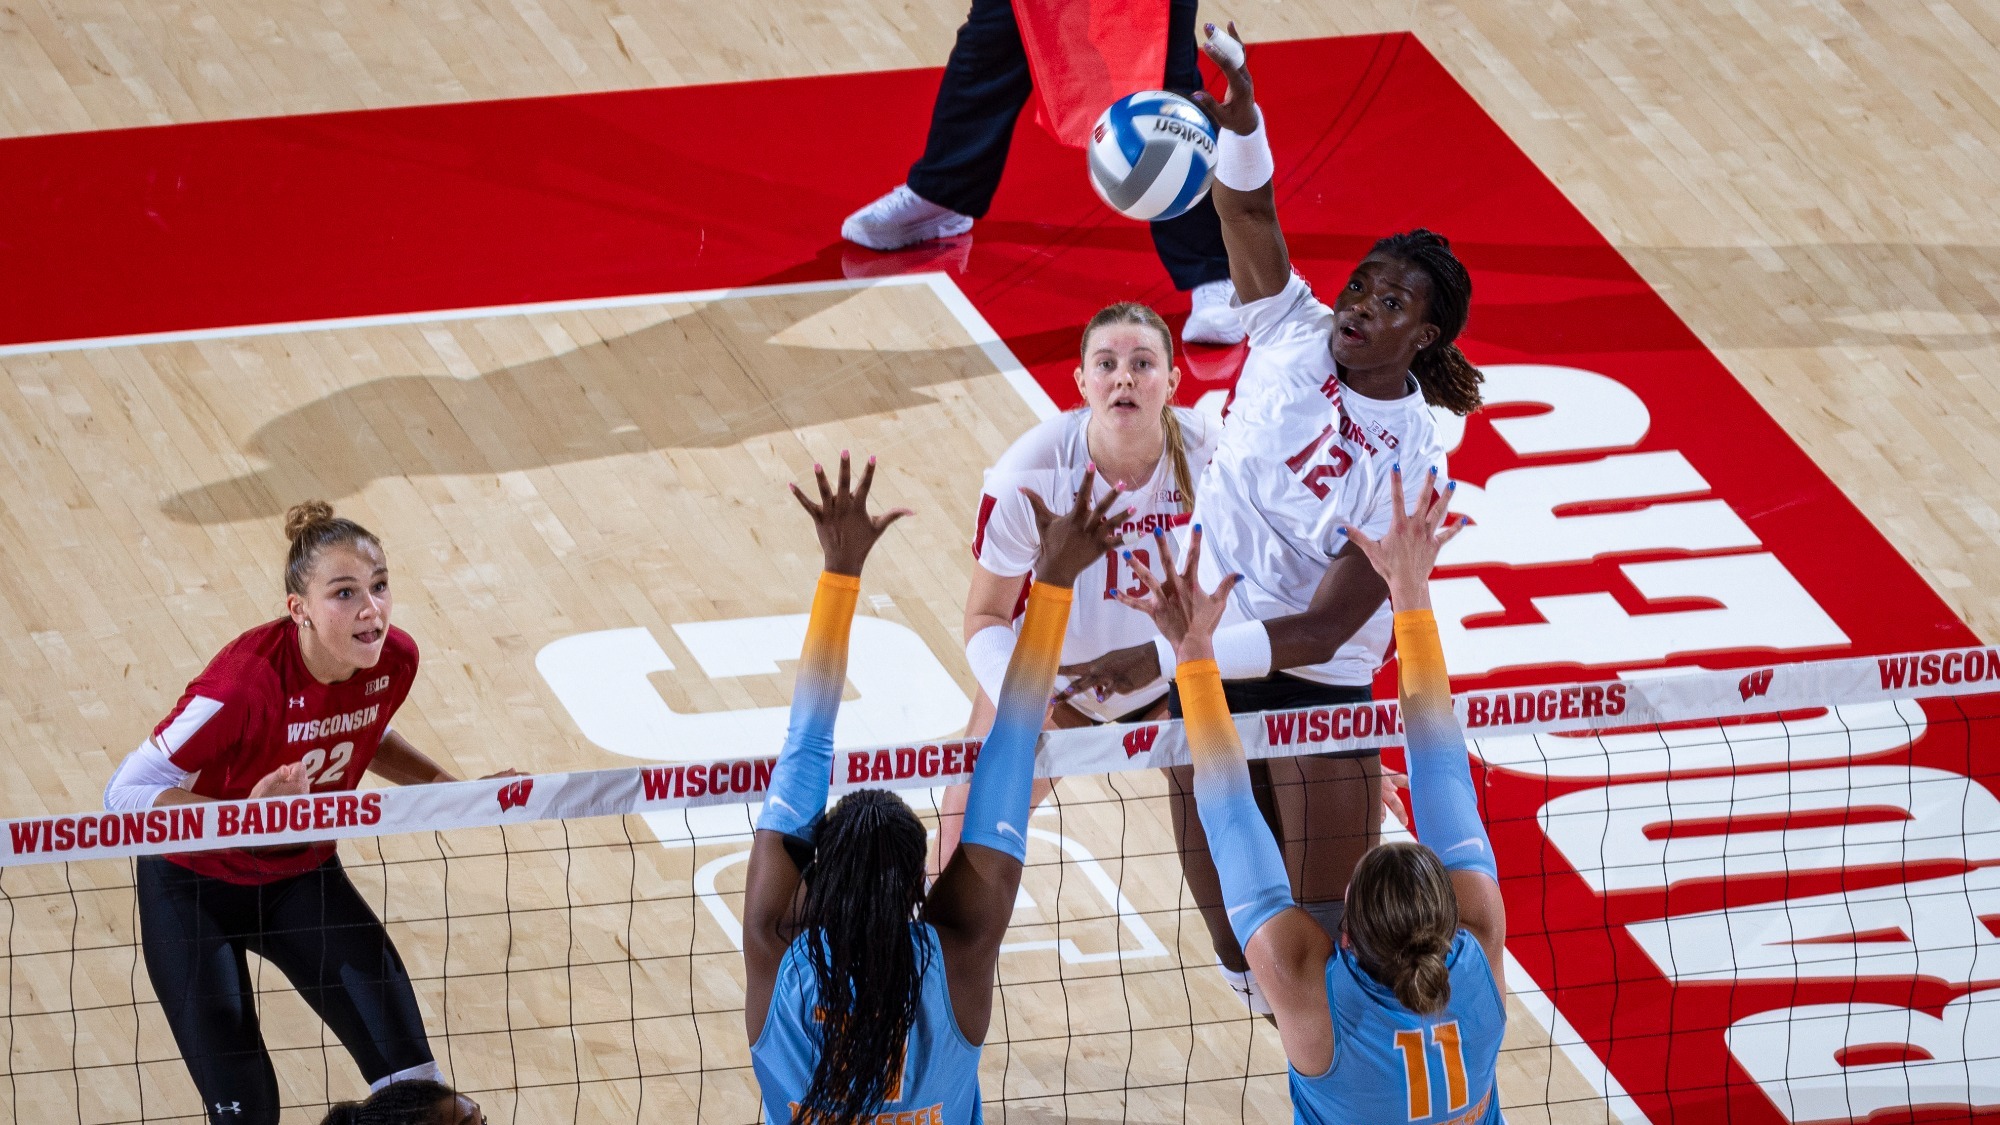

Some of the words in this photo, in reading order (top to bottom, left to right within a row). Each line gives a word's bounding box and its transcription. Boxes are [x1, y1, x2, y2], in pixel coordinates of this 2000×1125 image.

[1153, 117, 1214, 155] molten
[1284, 423, 1354, 501] 12
[1104, 549, 1150, 600] 13
[1738, 669, 1774, 702] W
[287, 703, 379, 743] WISCONSIN
[1265, 703, 1454, 746] WISCON
[1466, 683, 1626, 728] BADGERS
[301, 741, 354, 784] 22
[1122, 725, 1159, 760] W
[641, 755, 835, 801] WISCON
[847, 741, 983, 783] BADGER
[497, 779, 533, 814] W
[9, 806, 205, 855] WISCONSIN
[217, 793, 382, 837] BADGERS
[1393, 1020, 1469, 1122] 11
